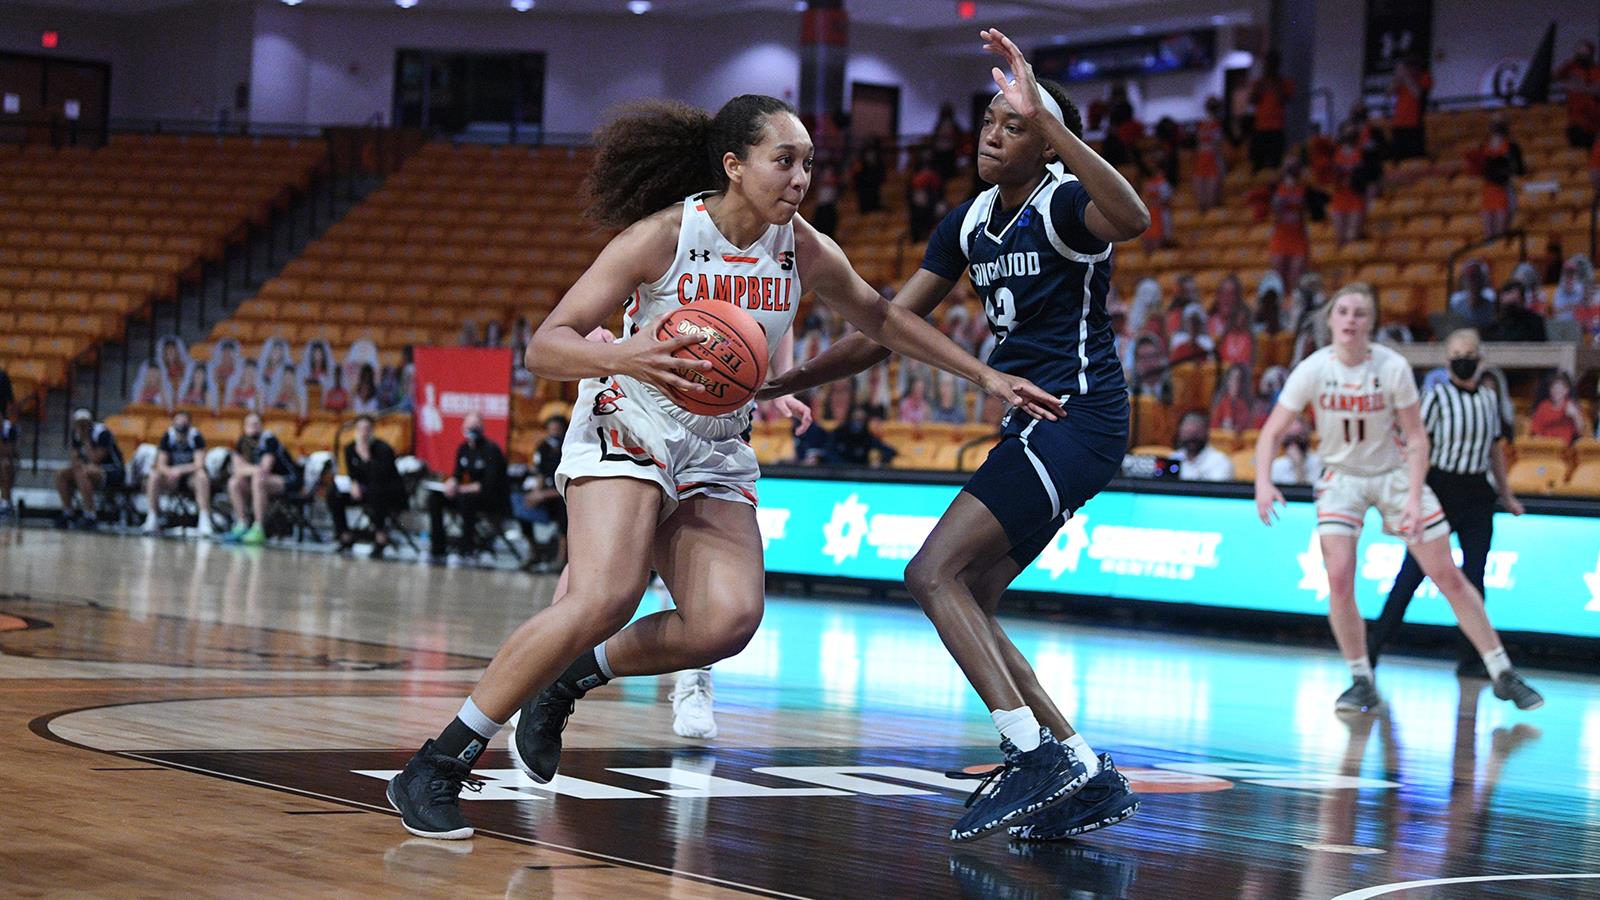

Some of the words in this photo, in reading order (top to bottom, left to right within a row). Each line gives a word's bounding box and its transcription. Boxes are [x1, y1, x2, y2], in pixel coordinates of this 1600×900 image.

[970, 251, 1041, 287] ONGWOD
[677, 273, 792, 311] CAMPBELL
[671, 368, 730, 398] SPALD
[1319, 392, 1385, 412] CAMPBELL
[1343, 418, 1365, 442] 11
